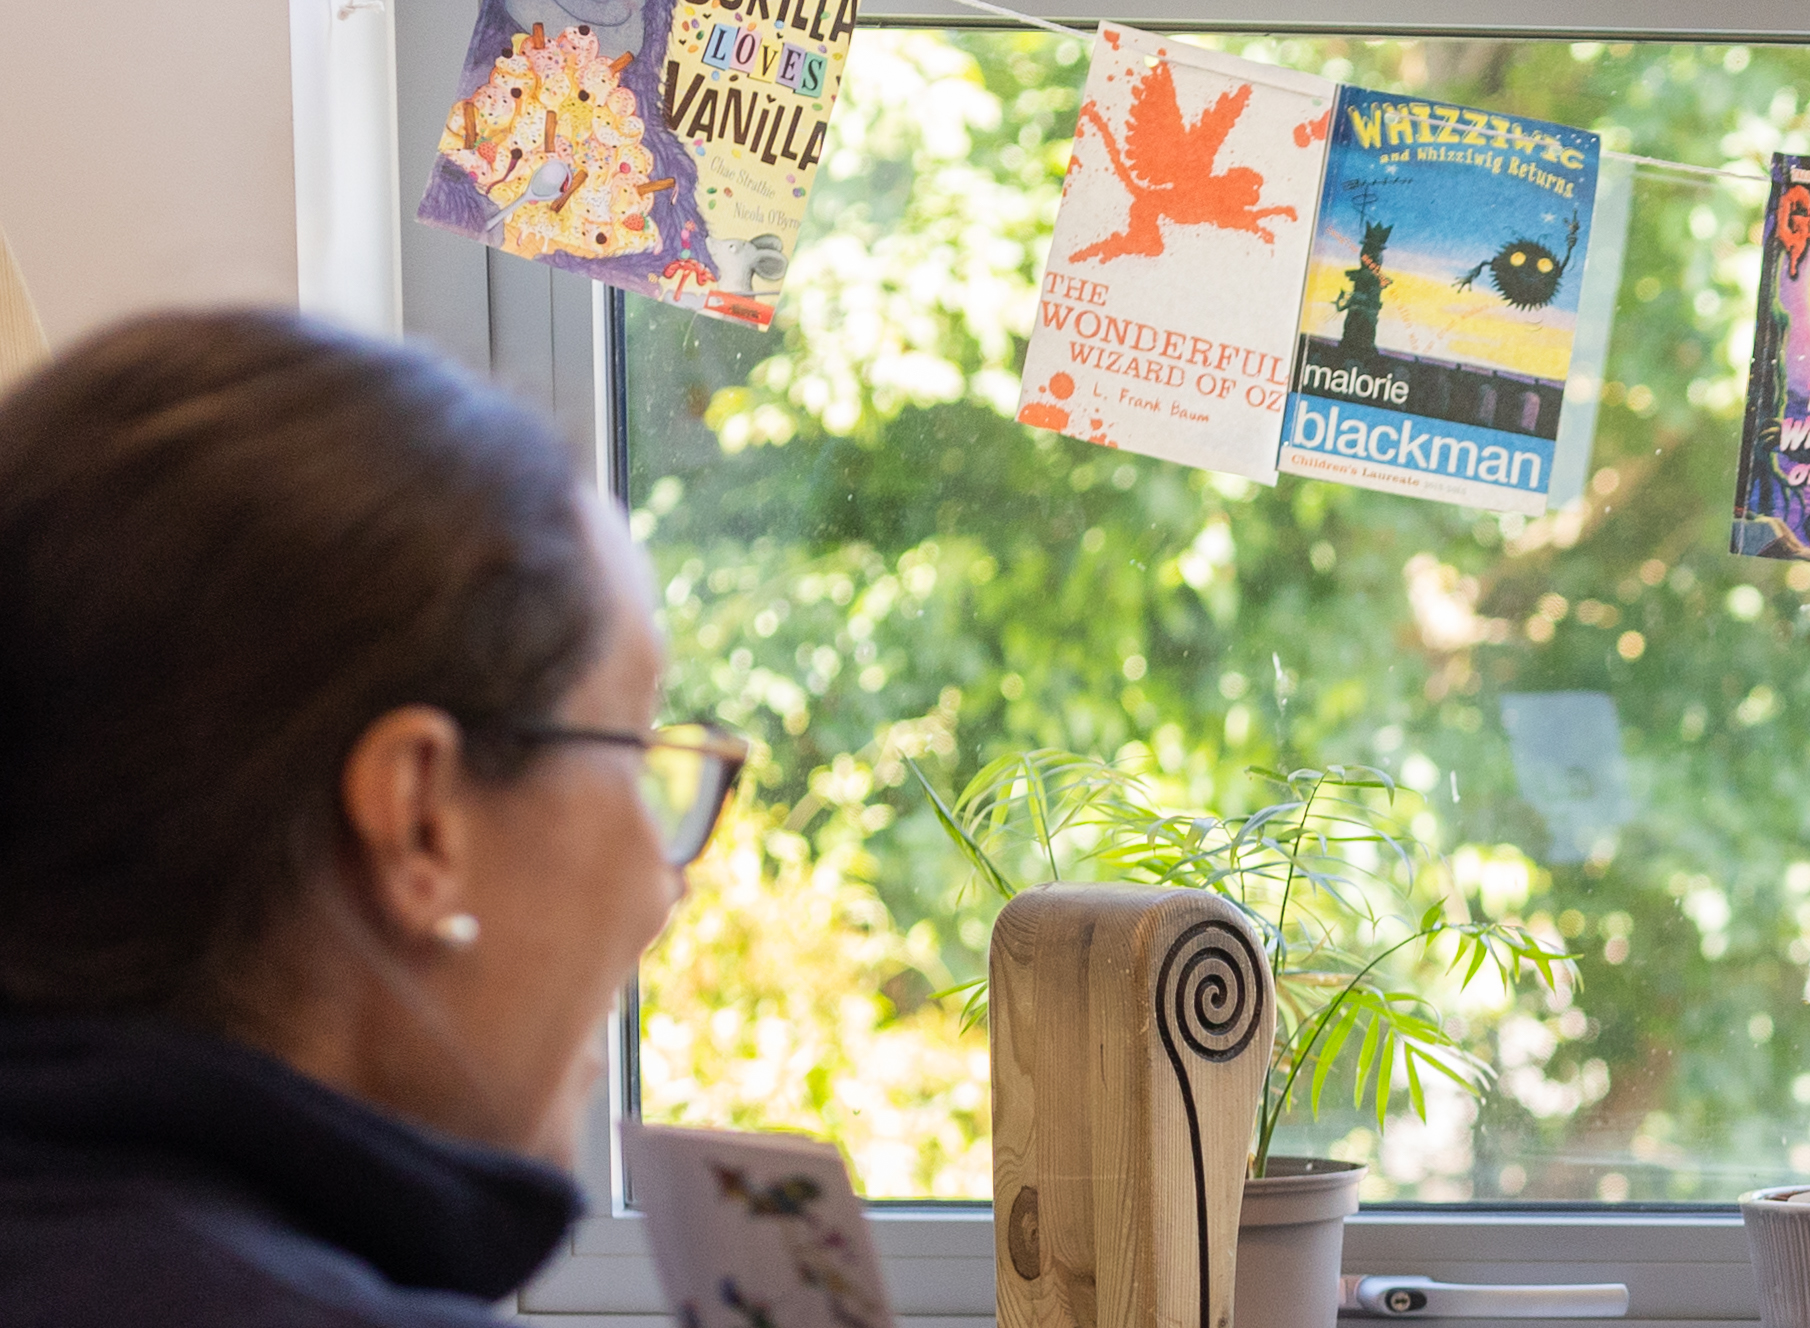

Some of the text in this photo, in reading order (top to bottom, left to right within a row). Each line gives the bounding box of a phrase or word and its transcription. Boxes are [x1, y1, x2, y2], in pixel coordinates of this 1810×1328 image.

[711, 29, 822, 91] LOVES
[1379, 147, 1575, 198] and Whizziwig Returns
[1046, 271, 1110, 306] THE
[1040, 300, 1289, 387] WONDERFUL
[1069, 341, 1286, 413] WIZARD OF OZ
[1092, 381, 1210, 424] L. Frank Baum
[1302, 362, 1410, 404] malorie
[1293, 400, 1542, 489] blackman
[1291, 454, 1358, 475] Children's
[1361, 467, 1420, 487] Laureate
